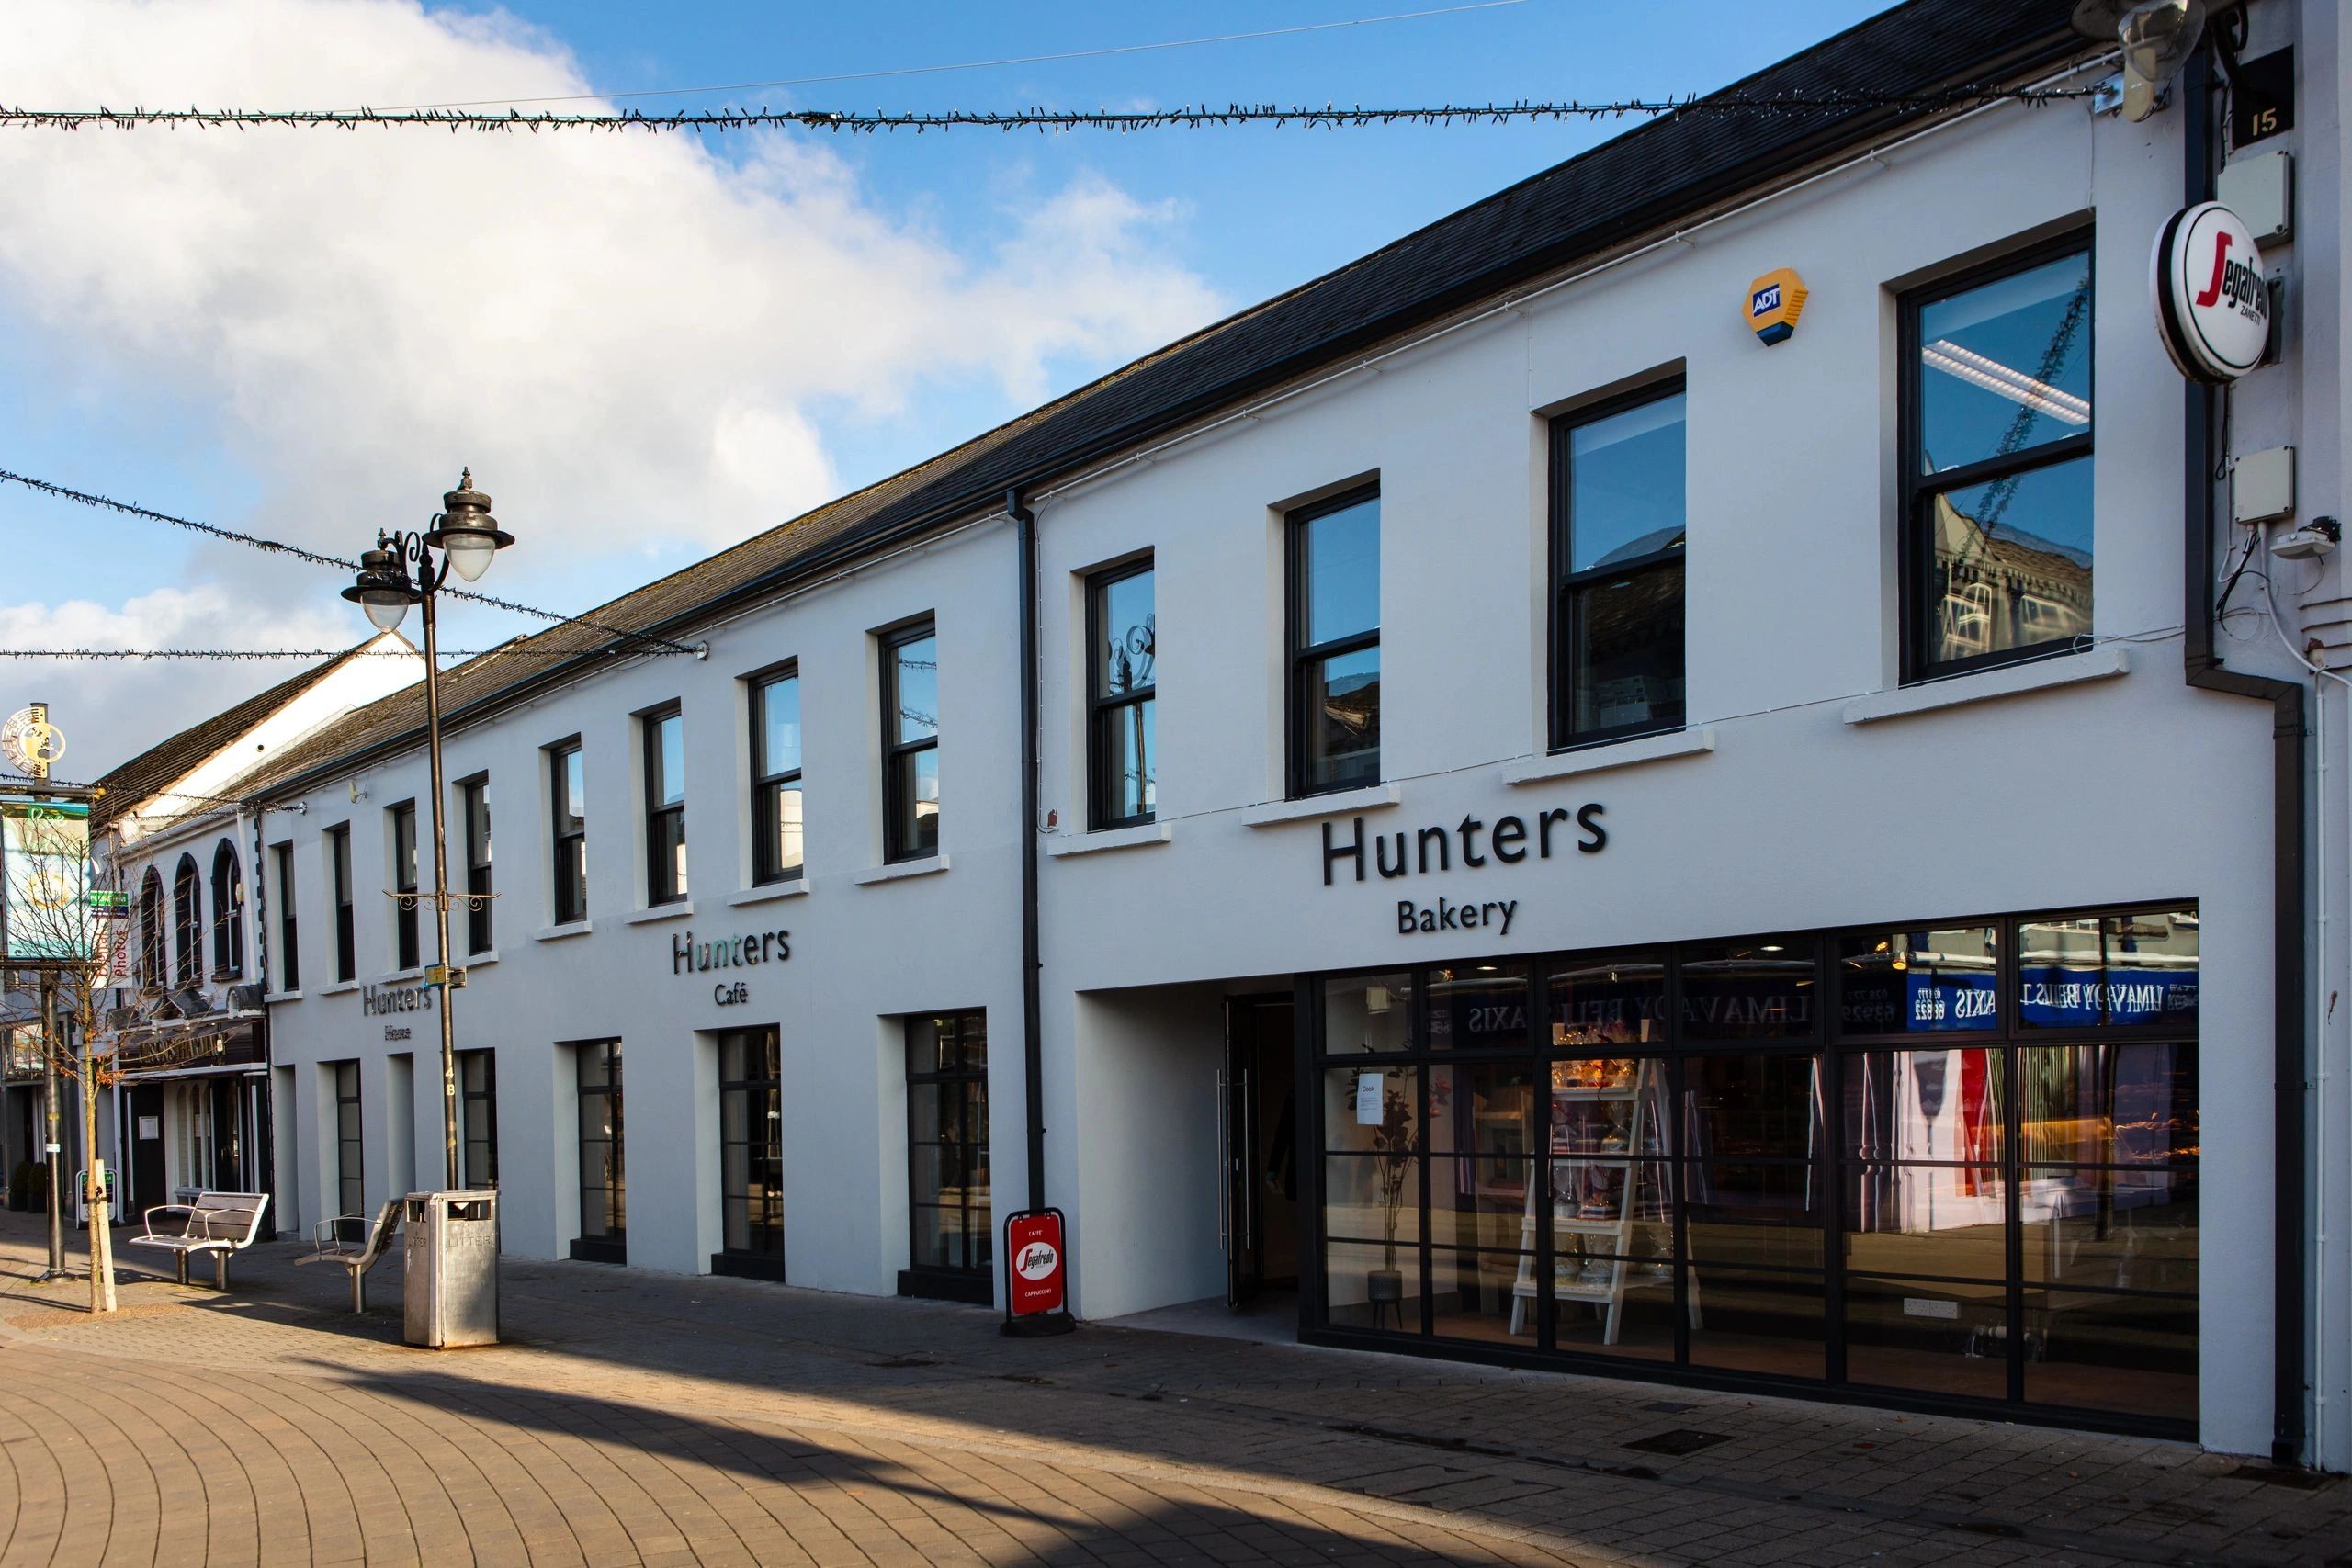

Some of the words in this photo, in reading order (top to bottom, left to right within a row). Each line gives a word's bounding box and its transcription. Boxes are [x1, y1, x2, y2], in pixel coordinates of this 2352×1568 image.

[2252, 107, 2277, 136] 15
[1753, 288, 1780, 313] ADT
[1321, 803, 1608, 886] Hunters
[1397, 897, 1518, 936] Bakery
[96, 931, 108, 977] Dgital
[114, 930, 127, 977] Photos
[673, 930, 791, 975] Hunters
[363, 985, 433, 1017] Hunters
[714, 982, 749, 1006] Café
[448, 1235, 491, 1247] LITTER
[1020, 1248, 1054, 1271] Segafredo
[1024, 1288, 1052, 1297] CAPPUCCINO
